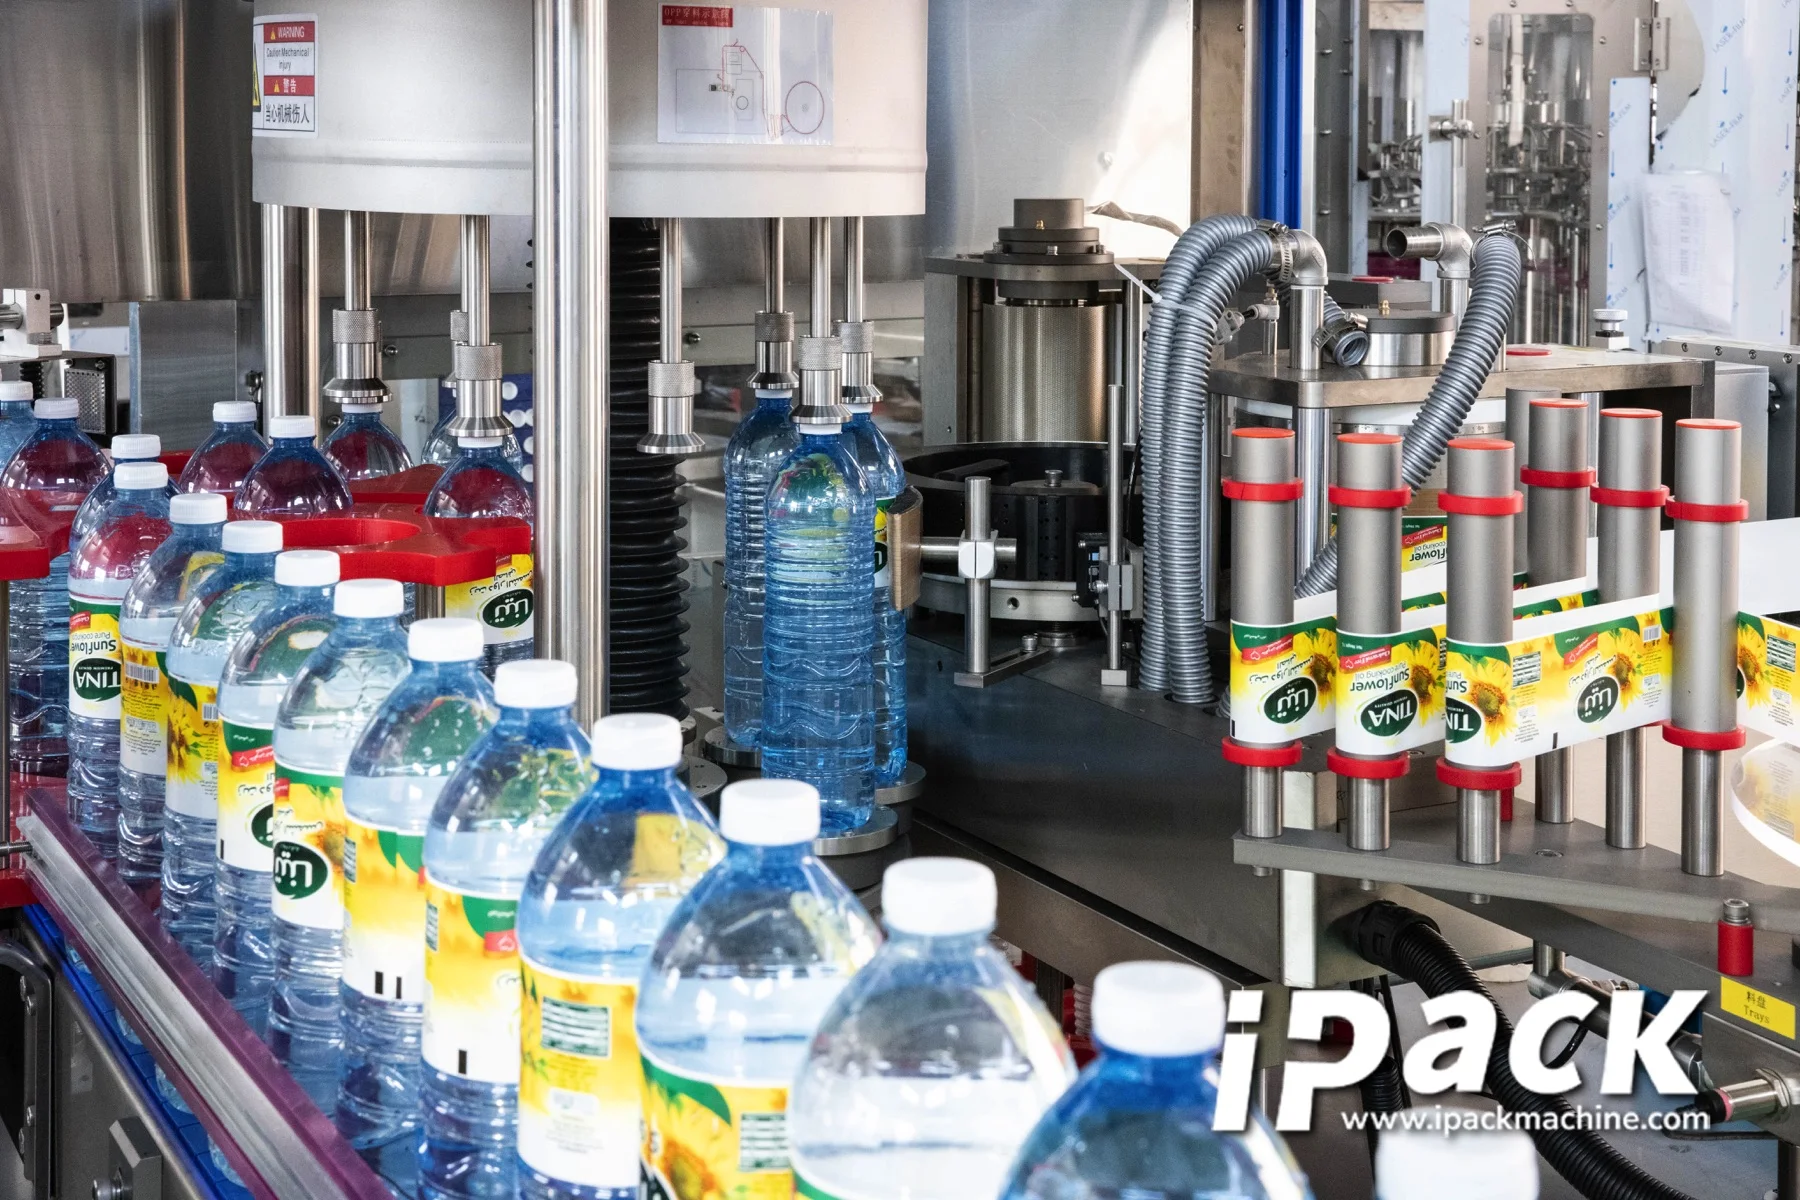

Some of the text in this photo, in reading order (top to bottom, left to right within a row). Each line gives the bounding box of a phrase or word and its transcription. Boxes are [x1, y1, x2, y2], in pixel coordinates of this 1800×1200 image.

[277, 26, 305, 38] WARNING
[266, 47, 310, 57] Caution Mechanical
[283, 78, 297, 93] 警告
[265, 103, 310, 124] 当心机械伤人
[1409, 548, 1447, 562] flower
[1423, 541, 1446, 551] cooking
[469, 585, 487, 596] زيت
[494, 597, 529, 623] تينا
[94, 632, 111, 640] Pure
[76, 670, 121, 688] TINA
[1248, 673, 1269, 685] زيت
[1349, 668, 1410, 693] Sunflower
[1276, 686, 1309, 719] تينا
[1583, 686, 1612, 716] تينا
[1367, 700, 1413, 727] TINA
[1746, 990, 1767, 1010] 料盘
[1743, 1004, 1770, 1025] Trays
